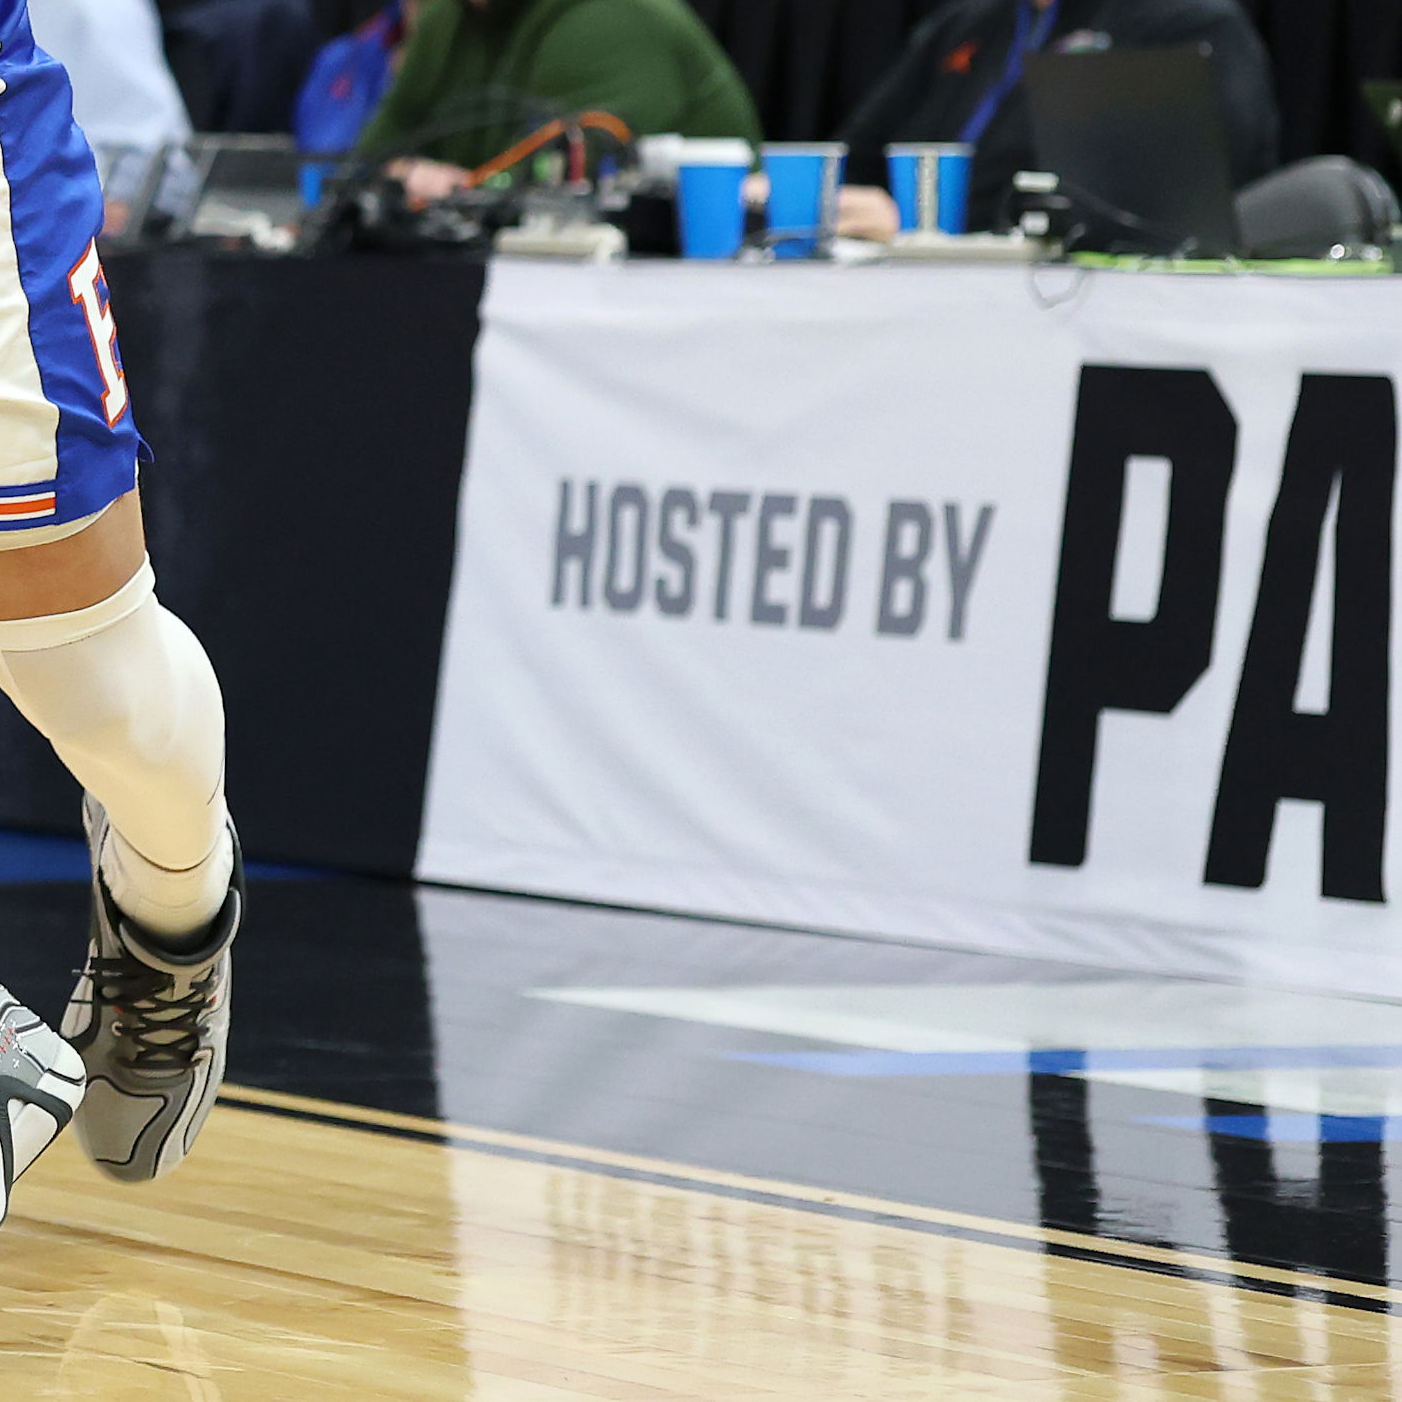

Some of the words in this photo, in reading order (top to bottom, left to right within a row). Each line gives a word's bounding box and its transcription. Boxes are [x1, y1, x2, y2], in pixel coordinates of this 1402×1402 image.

[550, 479, 853, 632] HOSTED
[877, 501, 996, 642] BY
[1029, 362, 1398, 904] PA
